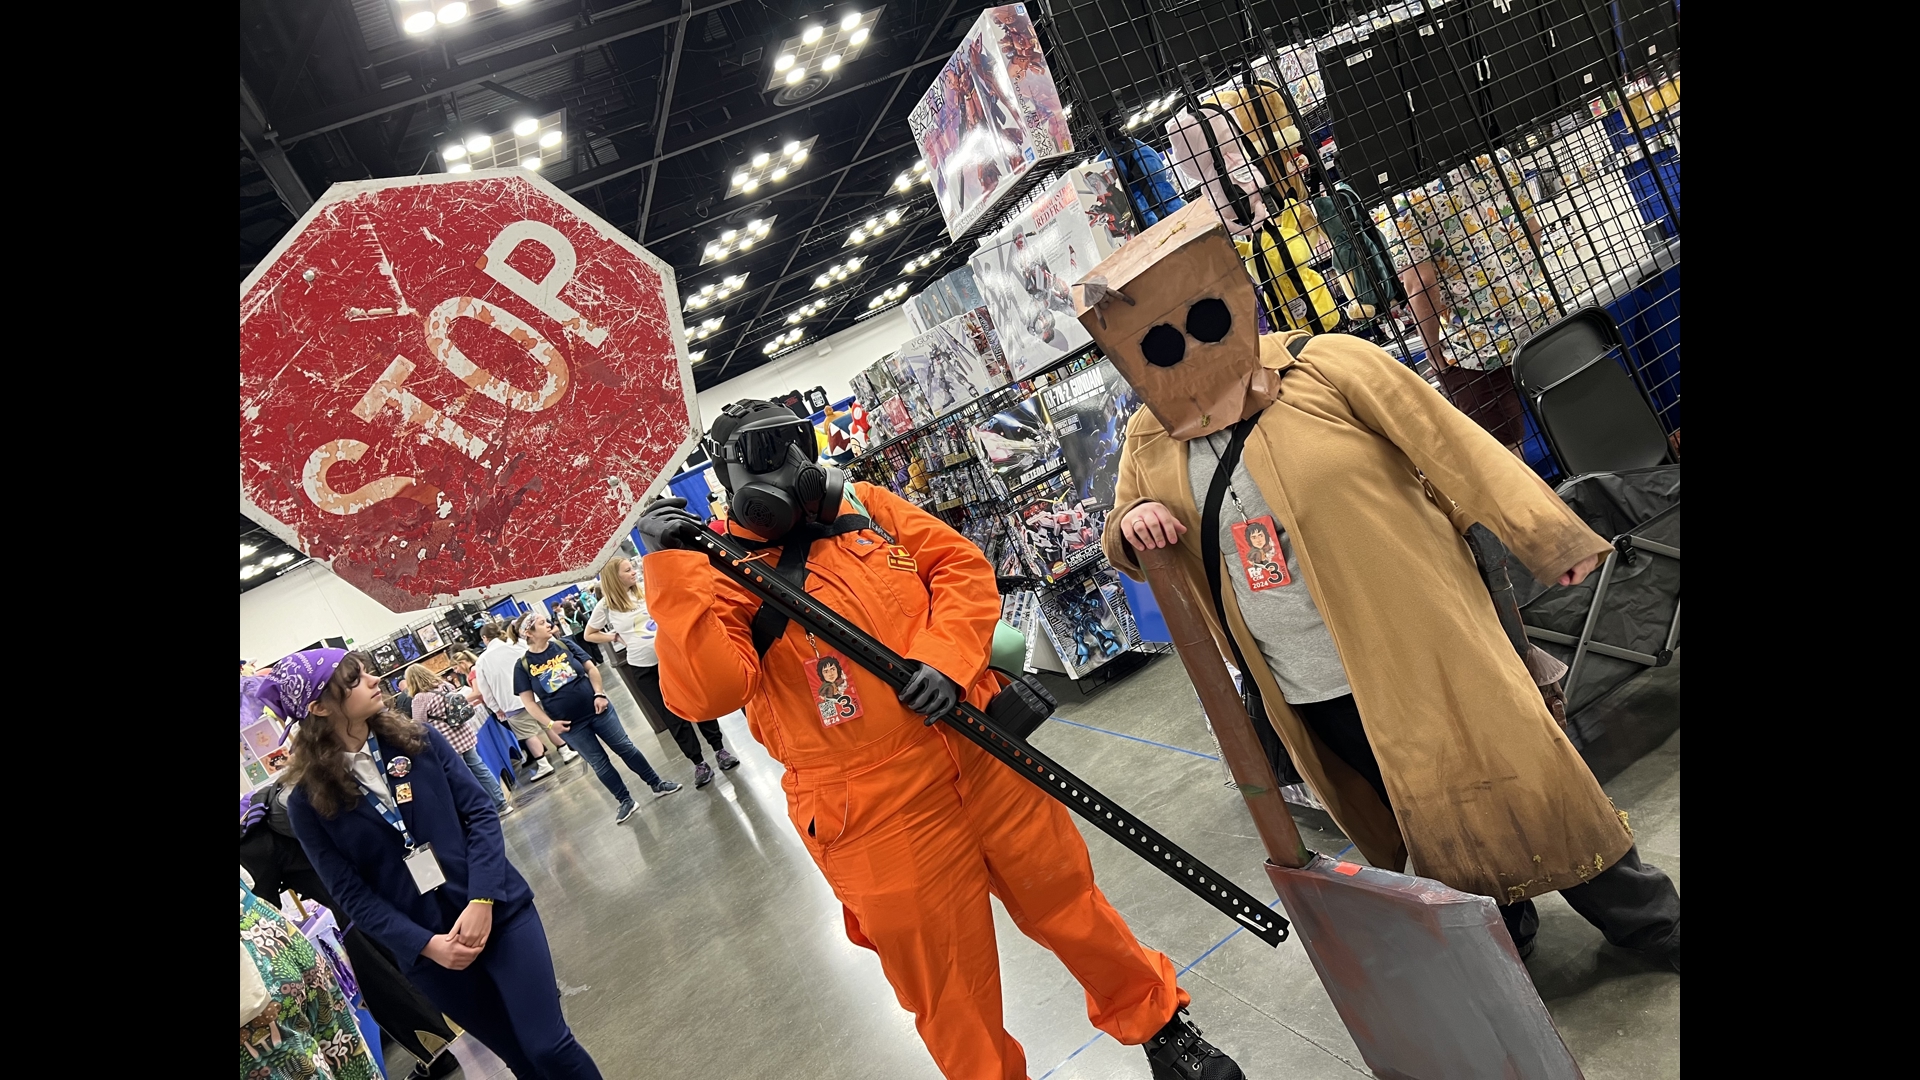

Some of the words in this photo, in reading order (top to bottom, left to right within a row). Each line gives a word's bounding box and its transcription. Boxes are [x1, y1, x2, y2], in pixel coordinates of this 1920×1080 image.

[914, 94, 945, 140] SAZABI
[302, 219, 609, 516] STOP
[1042, 382, 1071, 409] RX-78-2
[1068, 366, 1104, 397] GUNDAM
[1019, 464, 1046, 484] METEOR
[1044, 457, 1060, 472] UNIT
[1065, 541, 1101, 563] UNICORN
[1251, 580, 1268, 589] 2024
[1265, 562, 1284, 584] 3
[837, 694, 856, 718] 3
